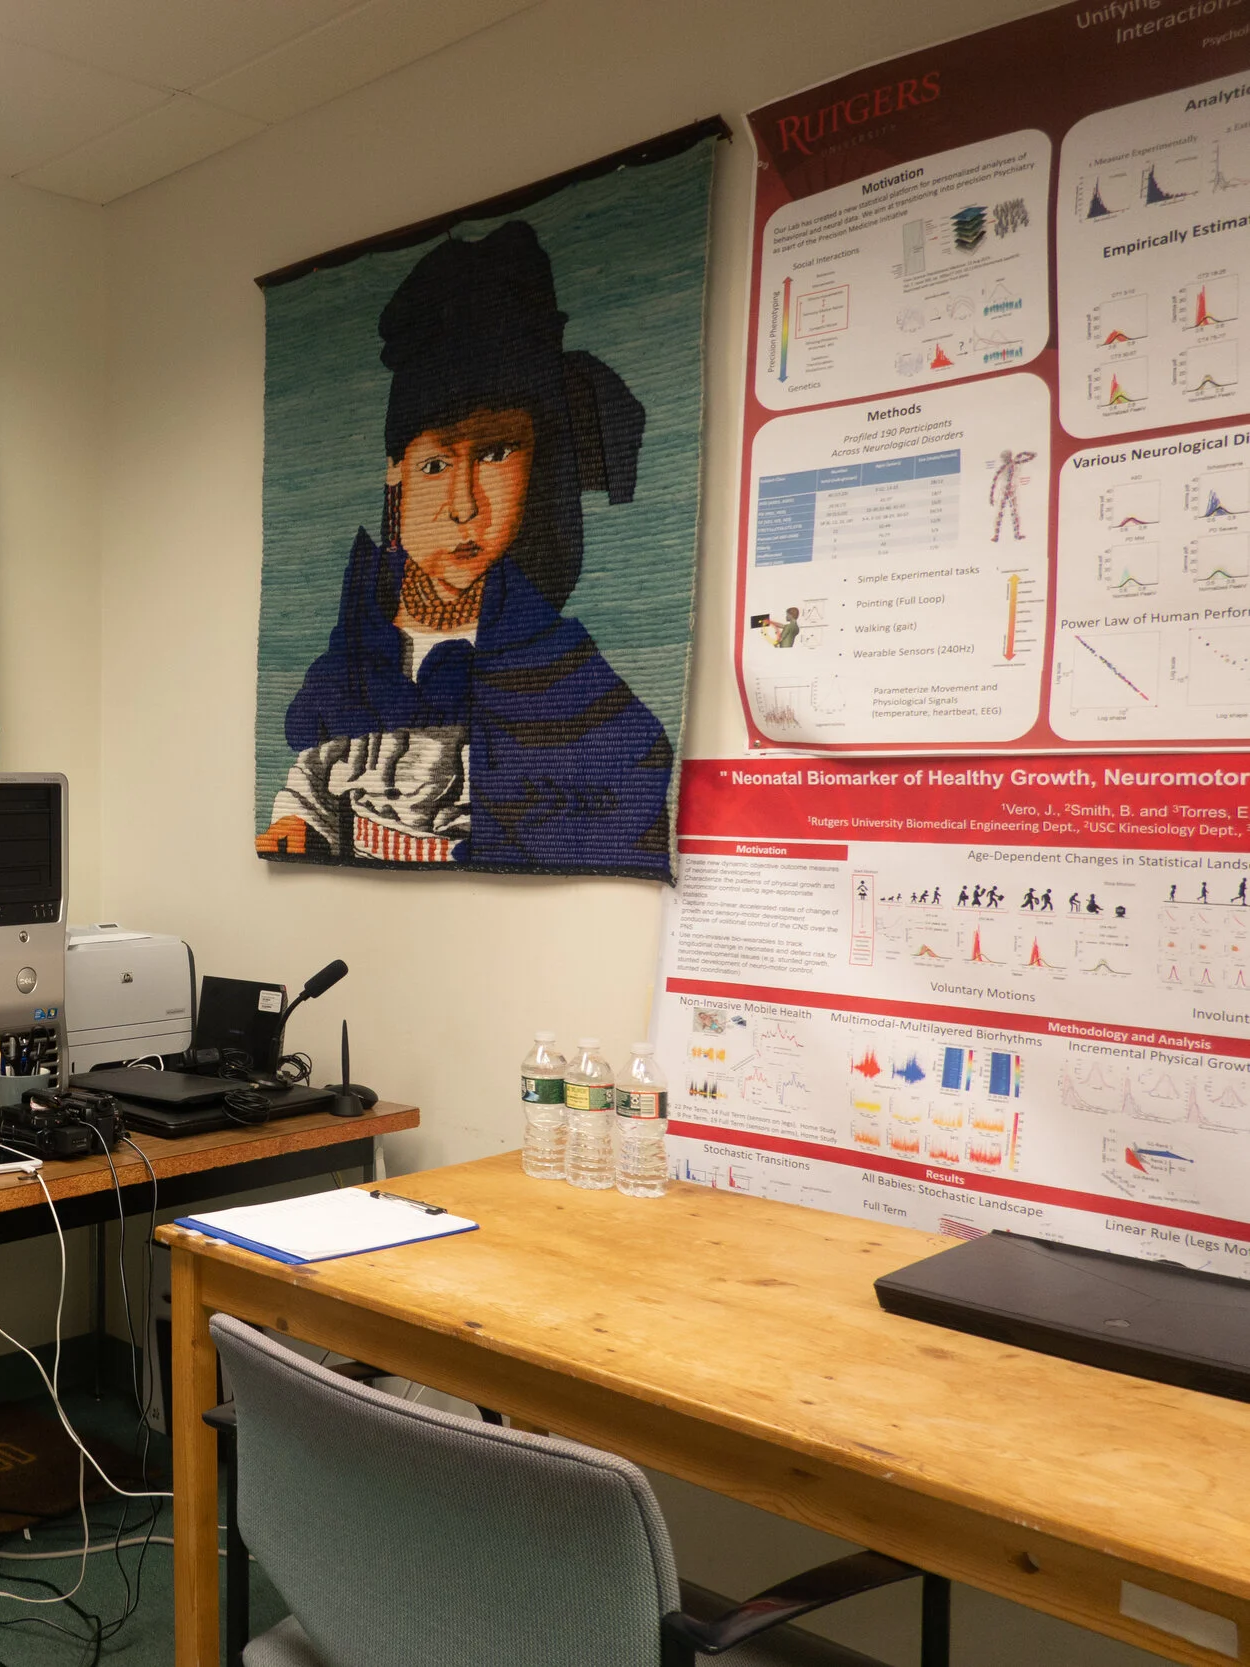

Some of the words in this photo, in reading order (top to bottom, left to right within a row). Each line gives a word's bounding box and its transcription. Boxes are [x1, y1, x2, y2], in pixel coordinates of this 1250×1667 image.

[777, 71, 940, 155] RUTGERS
[820, 124, 897, 157] UNIVERSITY
[861, 167, 924, 195] Motivation
[1103, 230, 1187, 258] Empirically
[1193, 214, 1250, 237] Estima
[793, 260, 814, 270] Social
[768, 341, 776, 372] Precision
[788, 382, 821, 392] Genetics
[867, 403, 922, 422] Methods
[844, 431, 878, 444] Profiled
[880, 428, 897, 440] 190
[900, 419, 952, 436] Participants
[831, 448, 860, 458] Across
[862, 437, 919, 454] Neurological
[921, 430, 964, 444] Disorders
[1073, 454, 1126, 469] Various
[1132, 436, 1228, 461] Neurological
[1234, 432, 1250, 445] Di
[858, 574, 888, 584] Simple
[890, 568, 953, 582] Experimental
[956, 566, 980, 576] tasks
[856, 598, 893, 609] Pointing
[896, 596, 916, 607] (Full
[918, 594, 945, 606] Loop)
[854, 622, 890, 634] Walking
[893, 622, 917, 632] (gait)
[1061, 619, 1100, 629] Power
[1104, 616, 1129, 626] Law
[1134, 613, 1147, 624] of
[1151, 610, 1199, 622] Human
[1204, 607, 1250, 619] Perfor
[854, 647, 896, 658] Wearable
[899, 646, 935, 656] Sensors
[874, 685, 929, 695] Parameterize
[931, 684, 978, 693] Movement
[980, 683, 998, 692] and
[872, 698, 925, 706] Physiological
[927, 696, 958, 706] Signals
[981, 706, 1002, 716] EEG)
[732, 771, 802, 785] Neonatal
[807, 771, 898, 786] Biomarker
[904, 771, 923, 785] of
[928, 770, 1003, 789] Healthy
[1010, 769, 1097, 788] Growth,
[1104, 769, 1250, 786] Neuromotor
[1120, 805, 1134, 816] B.
[1139, 806, 1167, 817] and
[1237, 806, 1248, 818] E
[851, 818, 902, 830] University
[906, 819, 966, 830] Biomedical
[970, 820, 1039, 834] Engineering
[1043, 821, 1080, 834] Dept.,
[1119, 823, 1194, 837] Kinesiology
[1200, 824, 1242, 837] Dept.,
[736, 845, 786, 855] Motivation
[968, 850, 1061, 864] Age-Dependent
[1065, 854, 1118, 866] Changes
[1123, 855, 1134, 866] in
[1139, 855, 1202, 868] Statistical
[931, 982, 983, 998] Voluntary
[987, 988, 1035, 1002] Motions
[680, 996, 741, 1011] Non-Invasive
[744, 1003, 777, 1015] Mobile
[780, 1007, 812, 1020] Health
[1193, 1008, 1250, 1024] Involunt
[830, 1012, 973, 1038] Multimodal-Multilayered
[976, 1030, 1043, 1047] Biorhythms
[1048, 1022, 1129, 1042] Methodology
[1131, 1032, 1155, 1043] and
[1158, 1034, 1212, 1050] Analysis
[1069, 1041, 1146, 1059] Incremental
[1150, 1051, 1203, 1067] Physical
[704, 1144, 753, 1160] Stochastic
[755, 1153, 810, 1170] Transitions
[926, 1169, 965, 1185] Results
[862, 1172, 875, 1184] All
[878, 1176, 916, 1193] Babies:
[918, 1184, 975, 1205] Stochastic
[979, 1196, 1044, 1218] Landscape
[863, 1200, 880, 1212] Full
[883, 1203, 907, 1217] Term
[1105, 1219, 1146, 1237] Linear
[1151, 1228, 1180, 1243] Rule
[1184, 1234, 1220, 1251] (Legs
